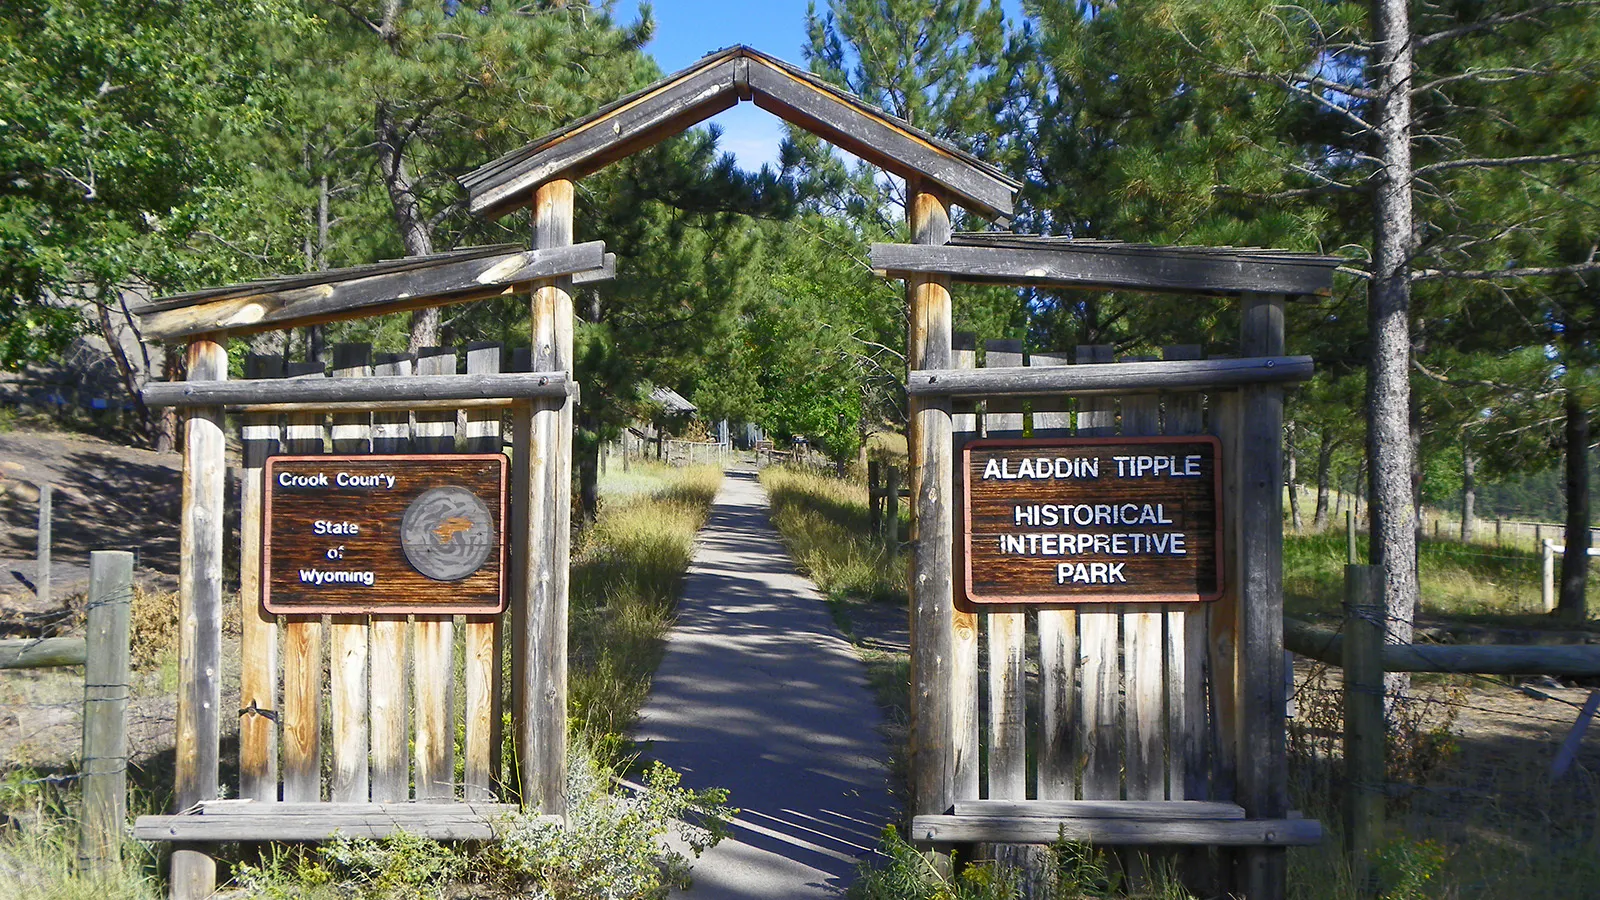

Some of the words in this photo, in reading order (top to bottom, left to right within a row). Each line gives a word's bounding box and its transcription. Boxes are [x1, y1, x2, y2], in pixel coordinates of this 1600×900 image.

[983, 456, 1099, 480] ALADDIN
[1113, 455, 1202, 477] TIPPLE
[278, 472, 328, 487] Crook
[1014, 503, 1173, 526] HISTORICAL
[313, 520, 359, 535] State
[1000, 533, 1187, 555] INTERPRETIVE
[299, 569, 374, 586] Wyoming
[1057, 562, 1126, 584] PARK
